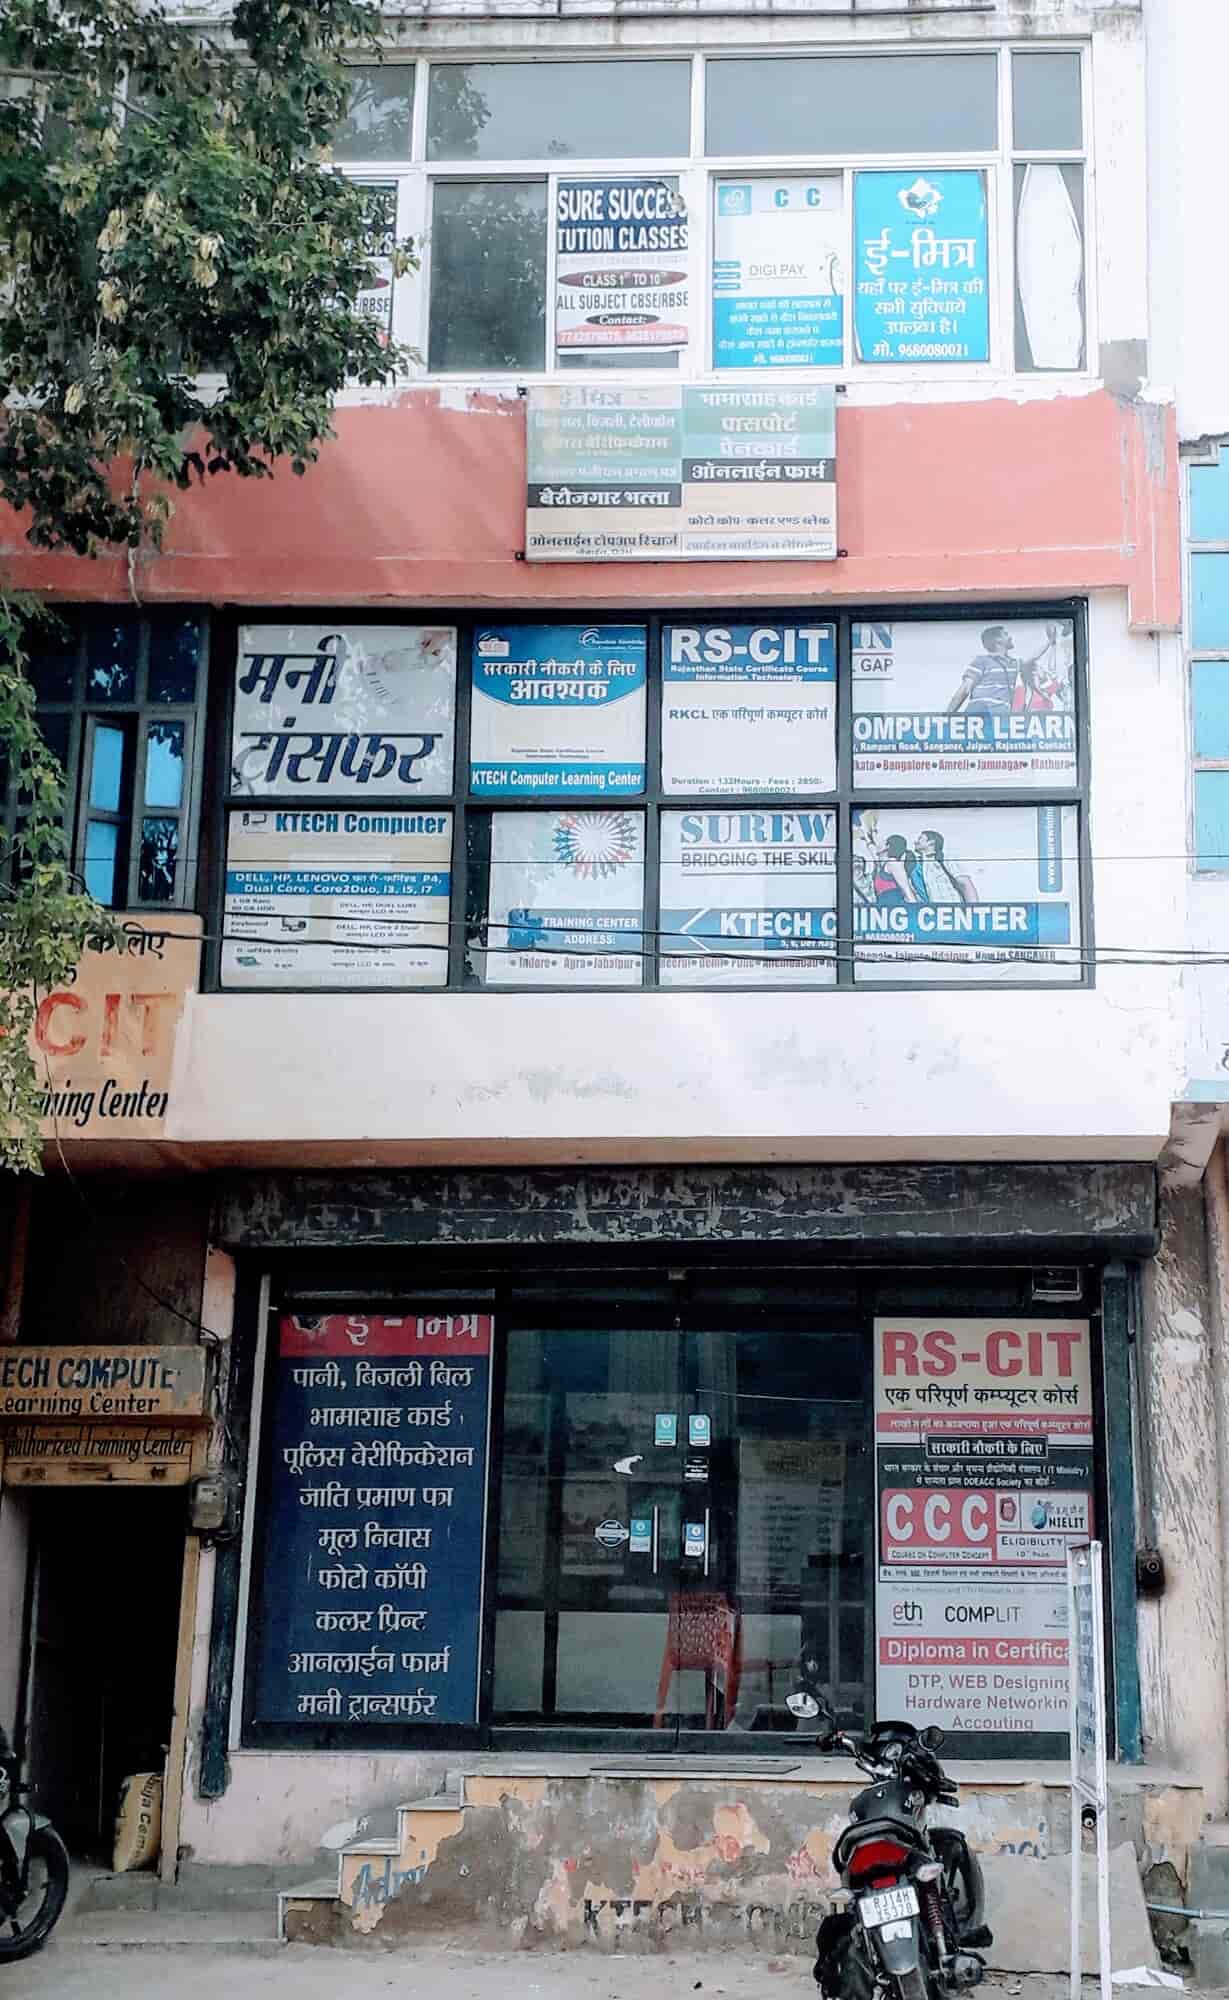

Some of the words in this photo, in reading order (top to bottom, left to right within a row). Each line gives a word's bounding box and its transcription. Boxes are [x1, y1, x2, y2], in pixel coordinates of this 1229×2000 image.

[559, 189, 604, 220] SURE
[558, 226, 614, 251] TUTION
[618, 224, 688, 249] CLASSES
[863, 226, 977, 274] ई-मित्र
[583, 275, 617, 287] CLASS
[632, 274, 647, 285] TO
[557, 295, 576, 310] ALL
[579, 293, 627, 309] SUBJECT
[631, 291, 688, 308] CBSE/RBSE
[670, 628, 829, 664] RS-CIT
[606, 659, 637, 676] लिए
[860, 658, 894, 673] GAP
[510, 679, 611, 700] आवश्यक
[669, 709, 710, 720] RKCL
[853, 716, 985, 740] OMPUTER
[472, 771, 508, 785] KTECH
[510, 771, 559, 788] Computer
[561, 771, 606, 788] Learning
[607, 771, 642, 785] Center
[275, 813, 339, 833] KTECH
[344, 813, 448, 836] Computer
[680, 814, 834, 844] SUREW
[681, 852, 758, 867] BRIDGING
[764, 851, 794, 866] THE
[798, 850, 836, 866] SKIL
[235, 873, 270, 883] DELL,
[296, 874, 350, 882] LENOVO
[244, 885, 274, 894] Dual
[543, 917, 594, 928] TRAINING
[596, 917, 639, 928] CENTER
[720, 911, 812, 937] KTECH
[917, 906, 1028, 931] CENTER
[100, 1079, 169, 1119] Center
[882, 1329, 1082, 1377] RS-CIT
[57, 1357, 182, 1390] COMPUTE
[292, 1360, 348, 1390] पानी,
[355, 1360, 424, 1387] बिजली
[429, 1360, 475, 1387] बिल
[90, 1391, 161, 1414] Center
[884, 1387, 911, 1404] एक
[915, 1383, 969, 1408] परिपूर्ण
[1042, 1383, 1079, 1404] कोर्स
[309, 1406, 403, 1427] भामाशाह
[406, 1399, 454, 1427] कार्ड
[282, 1440, 347, 1475] पूलिस
[350, 1440, 475, 1467] वेरीफिकेशन
[299, 1480, 351, 1508] जाति
[355, 1486, 417, 1510] प्रमाण
[421, 1486, 455, 1508] पत्र
[1048, 1517, 1085, 1529] NIELIT
[317, 1527, 360, 1557] मूल
[363, 1520, 433, 1548] निवास
[317, 1563, 369, 1590] फोटो
[374, 1561, 429, 1590] कॉपी
[315, 1610, 374, 1632] कलर
[400, 1644, 452, 1674] फार्म
[887, 1641, 965, 1665] Diploma
[972, 1641, 990, 1659] in
[908, 1673, 944, 1691] DTP,
[949, 1673, 988, 1690] WEB
[993, 1674, 1070, 1692] Designing
[296, 1687, 343, 1716] मनी
[905, 1695, 982, 1710] Hardware
[987, 1696, 1069, 1711] Networkin
